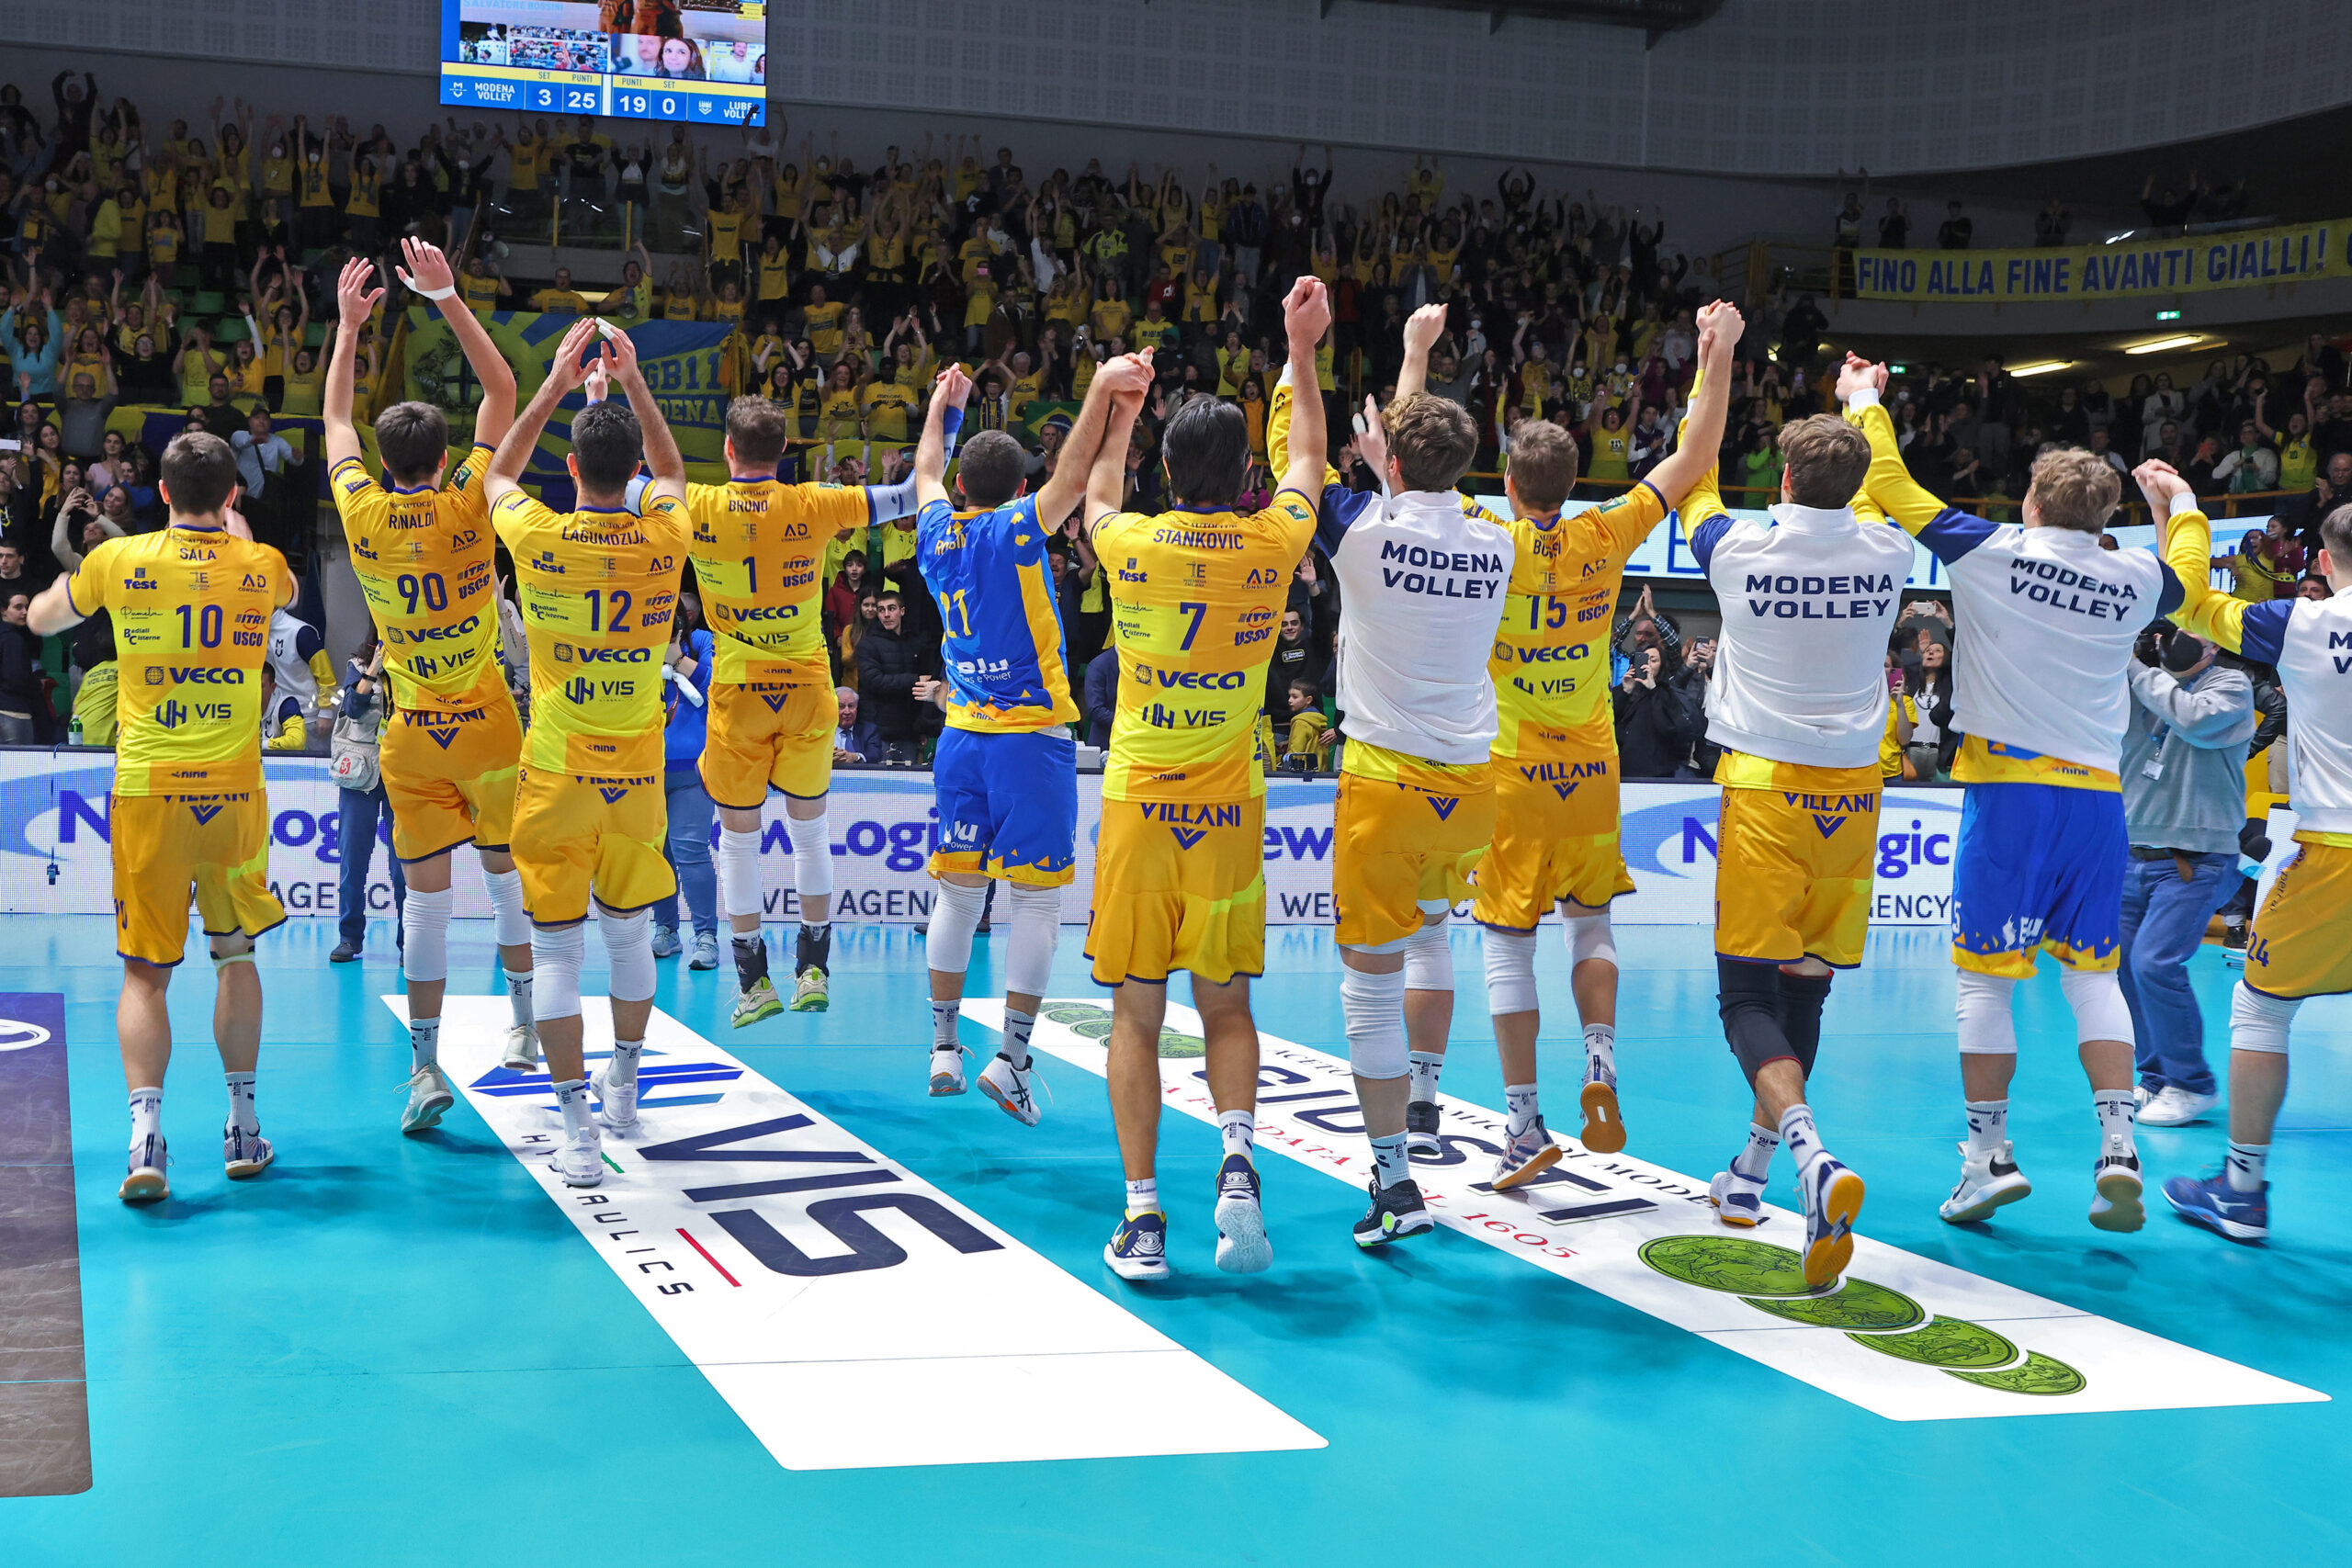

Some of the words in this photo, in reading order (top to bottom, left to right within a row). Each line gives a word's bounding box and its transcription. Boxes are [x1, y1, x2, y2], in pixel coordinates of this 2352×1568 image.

[538, 72, 550, 80] SET
[572, 73, 593, 83] PUNTI
[622, 77, 642, 86] PUNTI
[663, 81, 675, 89] SET
[475, 82, 515, 94] MODENA
[477, 92, 513, 102] VOLLEY
[538, 89, 551, 106] 3
[568, 91, 596, 109] 25
[619, 96, 646, 113] 19
[662, 98, 675, 114] 0
[1858, 257, 1916, 293] FINO
[1928, 260, 1994, 295] ALLA
[2007, 257, 2070, 294] FINE
[2081, 248, 2194, 291] AVANTI
[729, 500, 768, 513] BRUNO
[389, 512, 434, 529] RINALDI
[561, 526, 650, 546] LAGUMDZIJA
[693, 531, 717, 543] Test
[1153, 528, 1244, 549] STANKOVIC
[179, 547, 217, 561] SALA
[353, 543, 379, 560] Test
[1381, 540, 1504, 573] MODENA
[532, 559, 566, 574] Test
[742, 556, 757, 593] 1
[124, 580, 157, 590] Test
[783, 570, 814, 588] USCO
[1119, 570, 1148, 582] Test
[1383, 568, 1498, 599] VOLLEY
[1746, 574, 1894, 595] MODENA
[2010, 558, 2138, 601] MODENA
[397, 572, 448, 615] 90
[458, 574, 490, 600] USCO
[2010, 575, 2131, 622] VOLLEY
[584, 589, 633, 632] 12
[1526, 595, 1566, 630] 15
[1748, 598, 1891, 619] VOLLEY
[175, 604, 223, 649] 10
[642, 609, 673, 627] USCO
[1180, 602, 1207, 651] 7
[233, 631, 263, 647] USCO
[758, 633, 790, 644] VIS
[601, 681, 635, 695] VIS
[1542, 678, 1576, 694] VIS
[195, 704, 232, 720] VIS
[1184, 709, 1227, 727] VIS
[594, 744, 616, 752] nine
[1159, 773, 1185, 781] nine
[1520, 761, 1606, 782] VILLANI
[1783, 792, 1873, 813] VILLANI
[1140, 802, 1240, 827] VILLANI
[1874, 819, 1950, 878] gic
[2247, 931, 2269, 967] 24
[636, 1113, 1007, 1277] VIS
[1461, 1213, 1579, 1258] 1605
